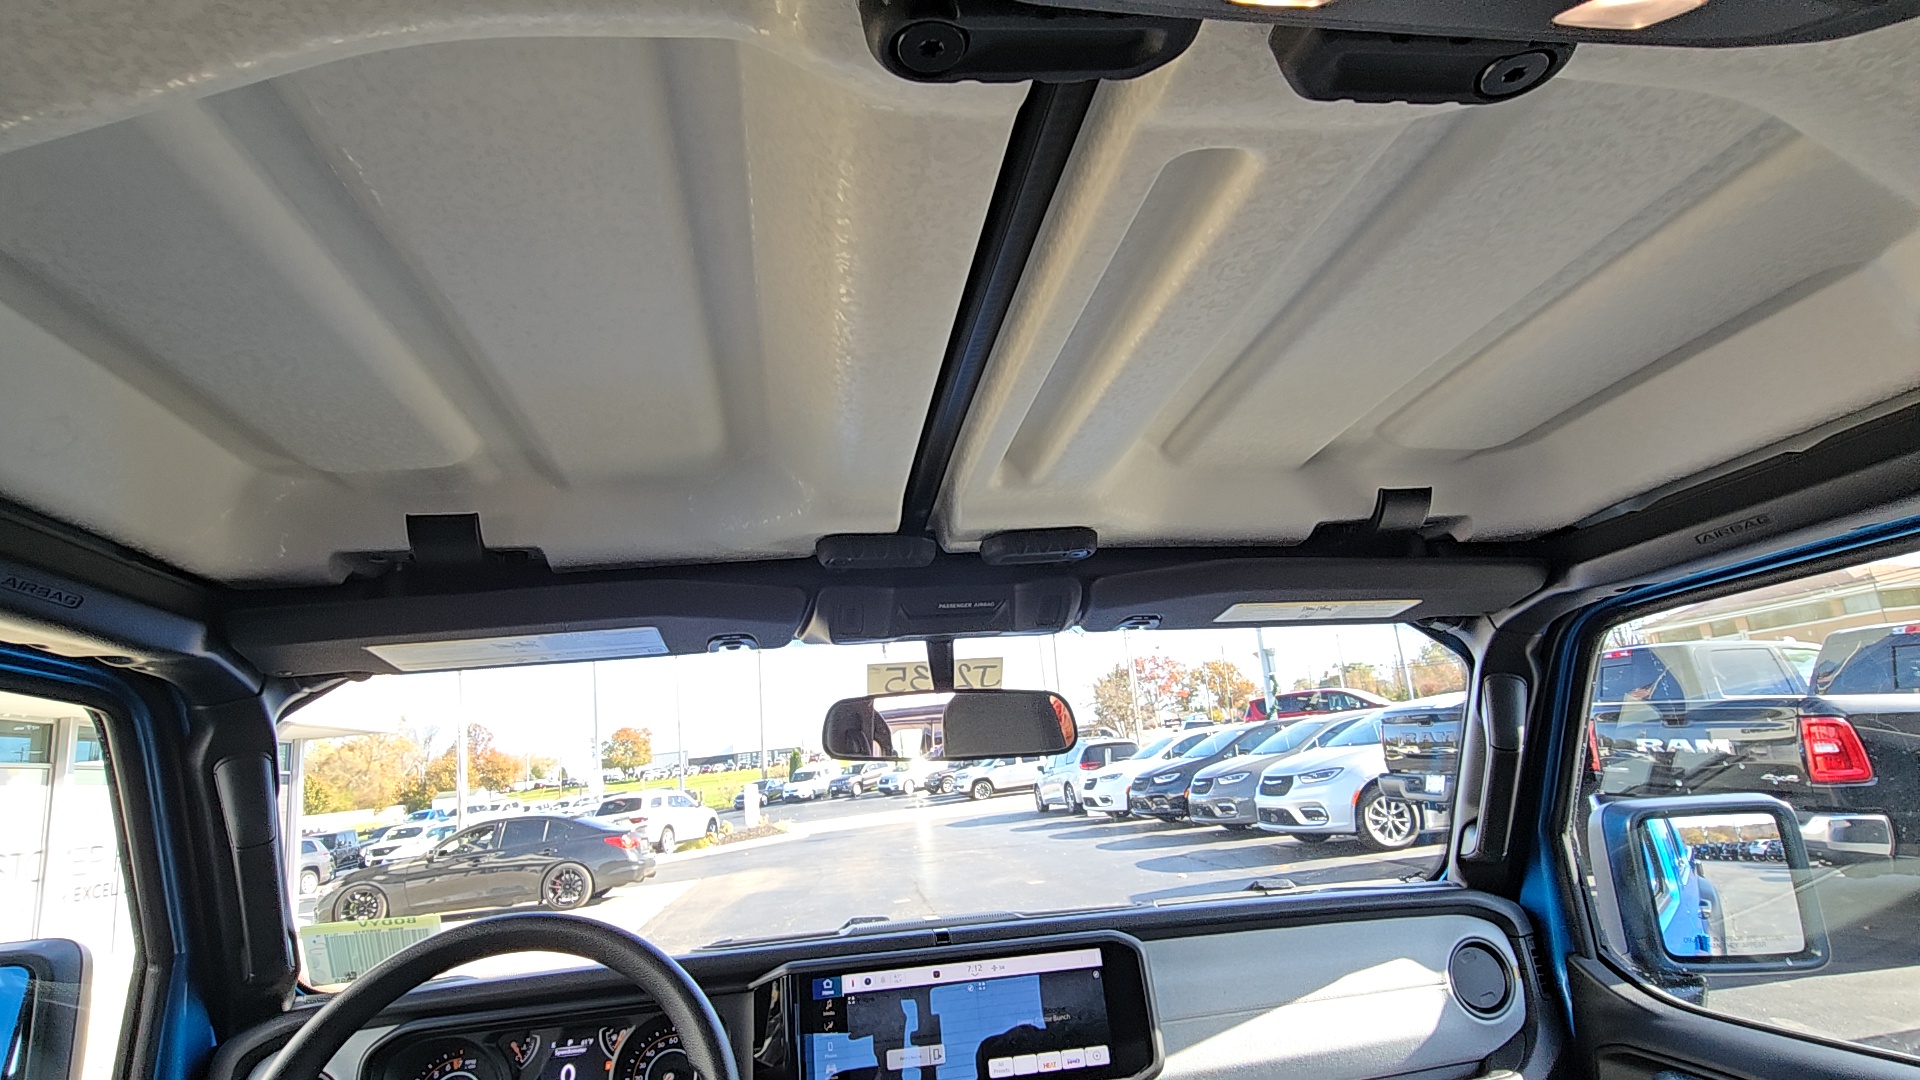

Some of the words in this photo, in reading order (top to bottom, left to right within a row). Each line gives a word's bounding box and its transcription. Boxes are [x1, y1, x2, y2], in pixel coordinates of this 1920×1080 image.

[1, 577, 79, 605] AIRBAG
[1400, 730, 1458, 748] RAM
[1636, 738, 1736, 756] RAM
